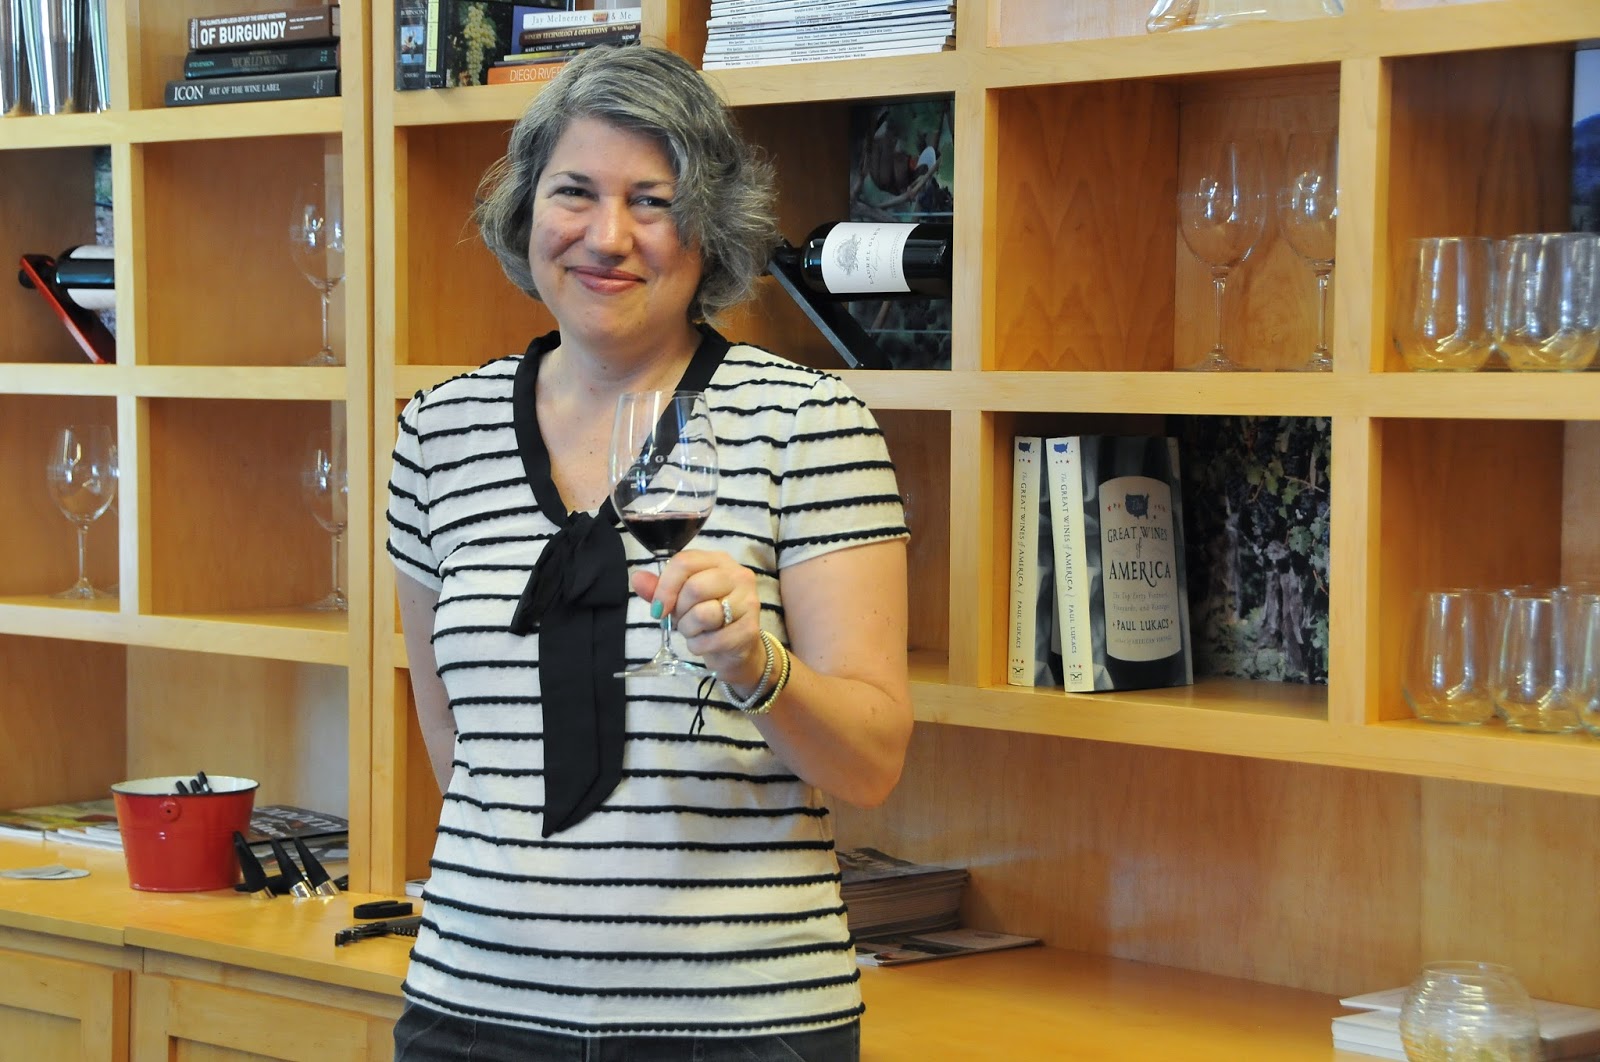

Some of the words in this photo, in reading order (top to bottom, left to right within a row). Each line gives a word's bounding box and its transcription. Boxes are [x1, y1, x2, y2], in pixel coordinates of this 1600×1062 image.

[532, 16, 542, 25] Jay
[547, 14, 587, 23] McInerney
[620, 12, 632, 20] Me
[201, 28, 216, 45] OF
[219, 21, 286, 44] BURGUNDY
[543, 29, 573, 39] TECHNOLOGY
[578, 26, 608, 36] OPERATIONS
[232, 56, 263, 67] WORLD
[263, 54, 288, 65] WINE
[510, 68, 537, 82] DIEGO
[174, 85, 204, 100] ICON
[209, 86, 220, 95] ART
[244, 84, 260, 92] WINE
[262, 83, 280, 92] LABEL
[1108, 526, 1137, 543] GREAT
[1140, 526, 1168, 541] WINES
[1136, 536, 1142, 559] of
[1065, 551, 1073, 591] AMERICA
[1109, 560, 1171, 588] AMERICA
[1117, 620, 1136, 631] PAUL
[1140, 619, 1169, 631] LUKACS
